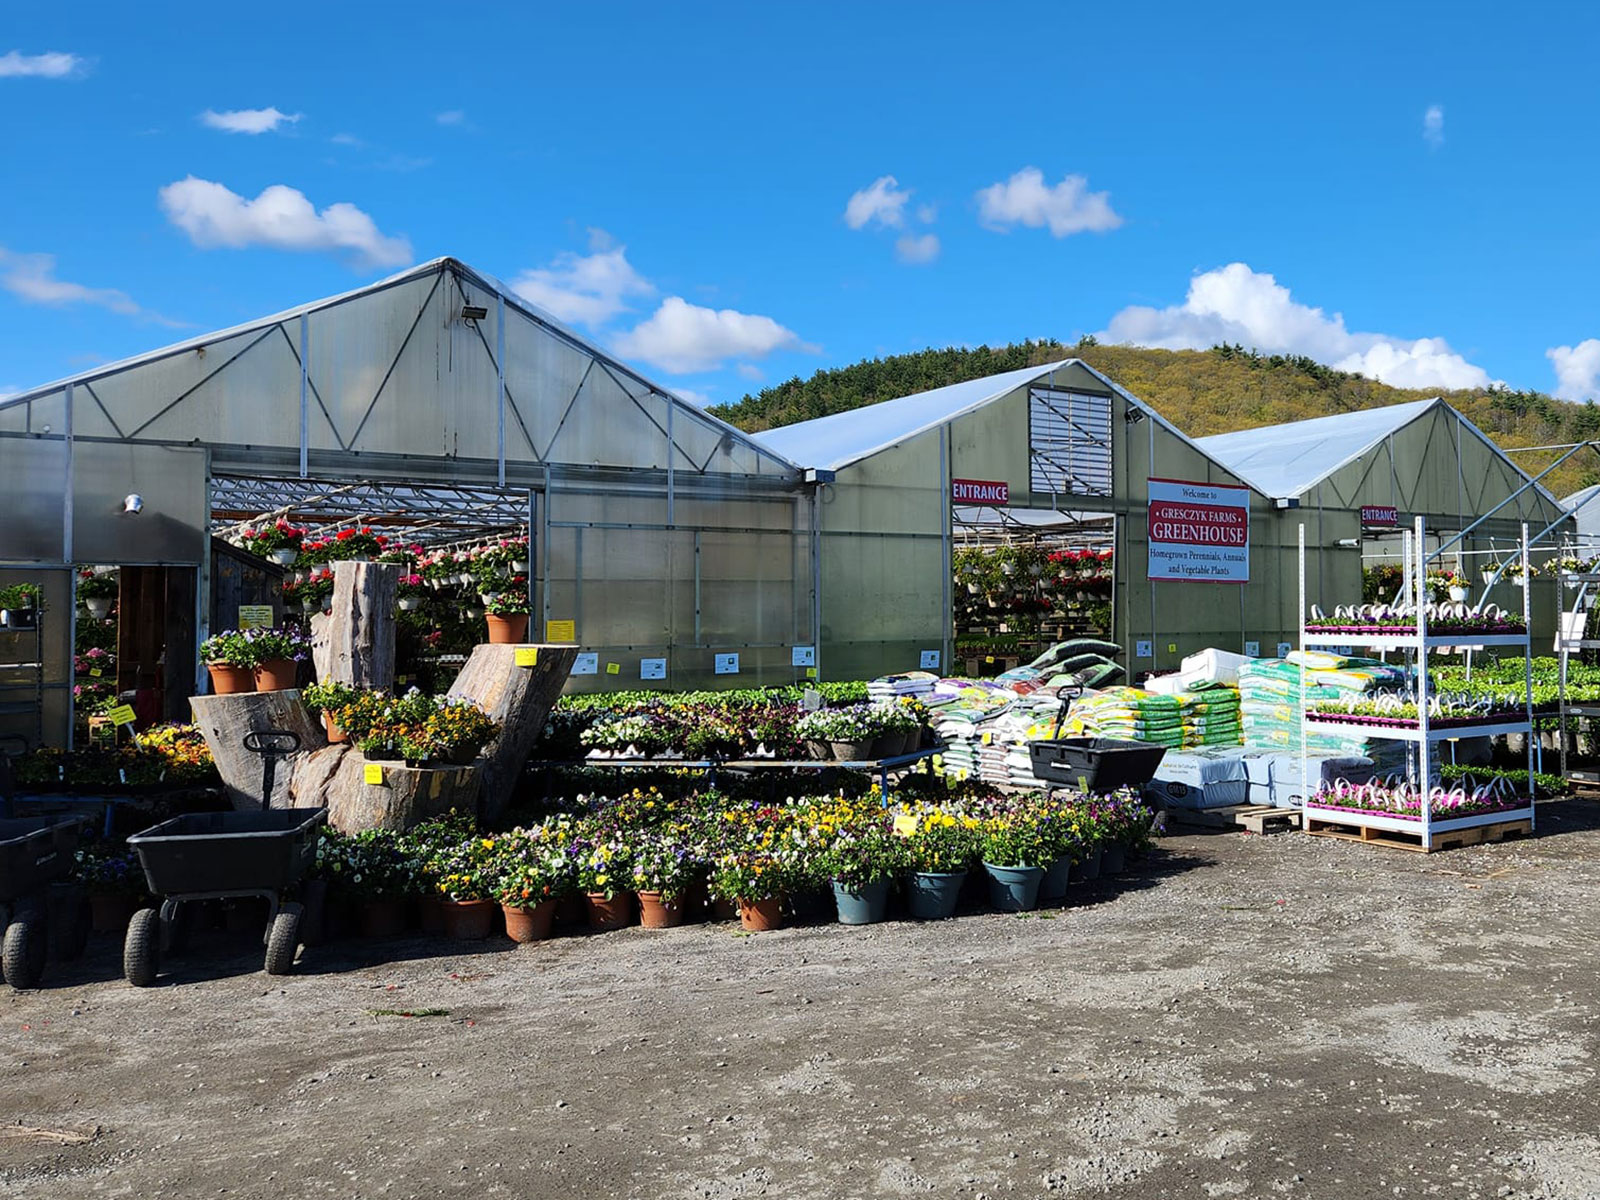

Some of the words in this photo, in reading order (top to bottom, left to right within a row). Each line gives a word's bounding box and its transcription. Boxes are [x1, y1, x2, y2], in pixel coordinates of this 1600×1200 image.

[953, 483, 1008, 501] ENTRANCE
[1182, 488, 1210, 499] Welcome
[1210, 491, 1217, 500] to
[1161, 507, 1207, 521] GRESCZYK
[1208, 511, 1237, 524] FARMS
[1362, 509, 1398, 521] ENTRANCE
[1153, 522, 1244, 543] GREENHOUSE
[1150, 548, 1188, 561] Homegrown
[1189, 550, 1221, 562] Perennials,
[1223, 552, 1246, 562] Annuals
[1168, 564, 1180, 573] and
[1180, 564, 1209, 576] Vegetable
[1211, 565, 1230, 575] Plants
